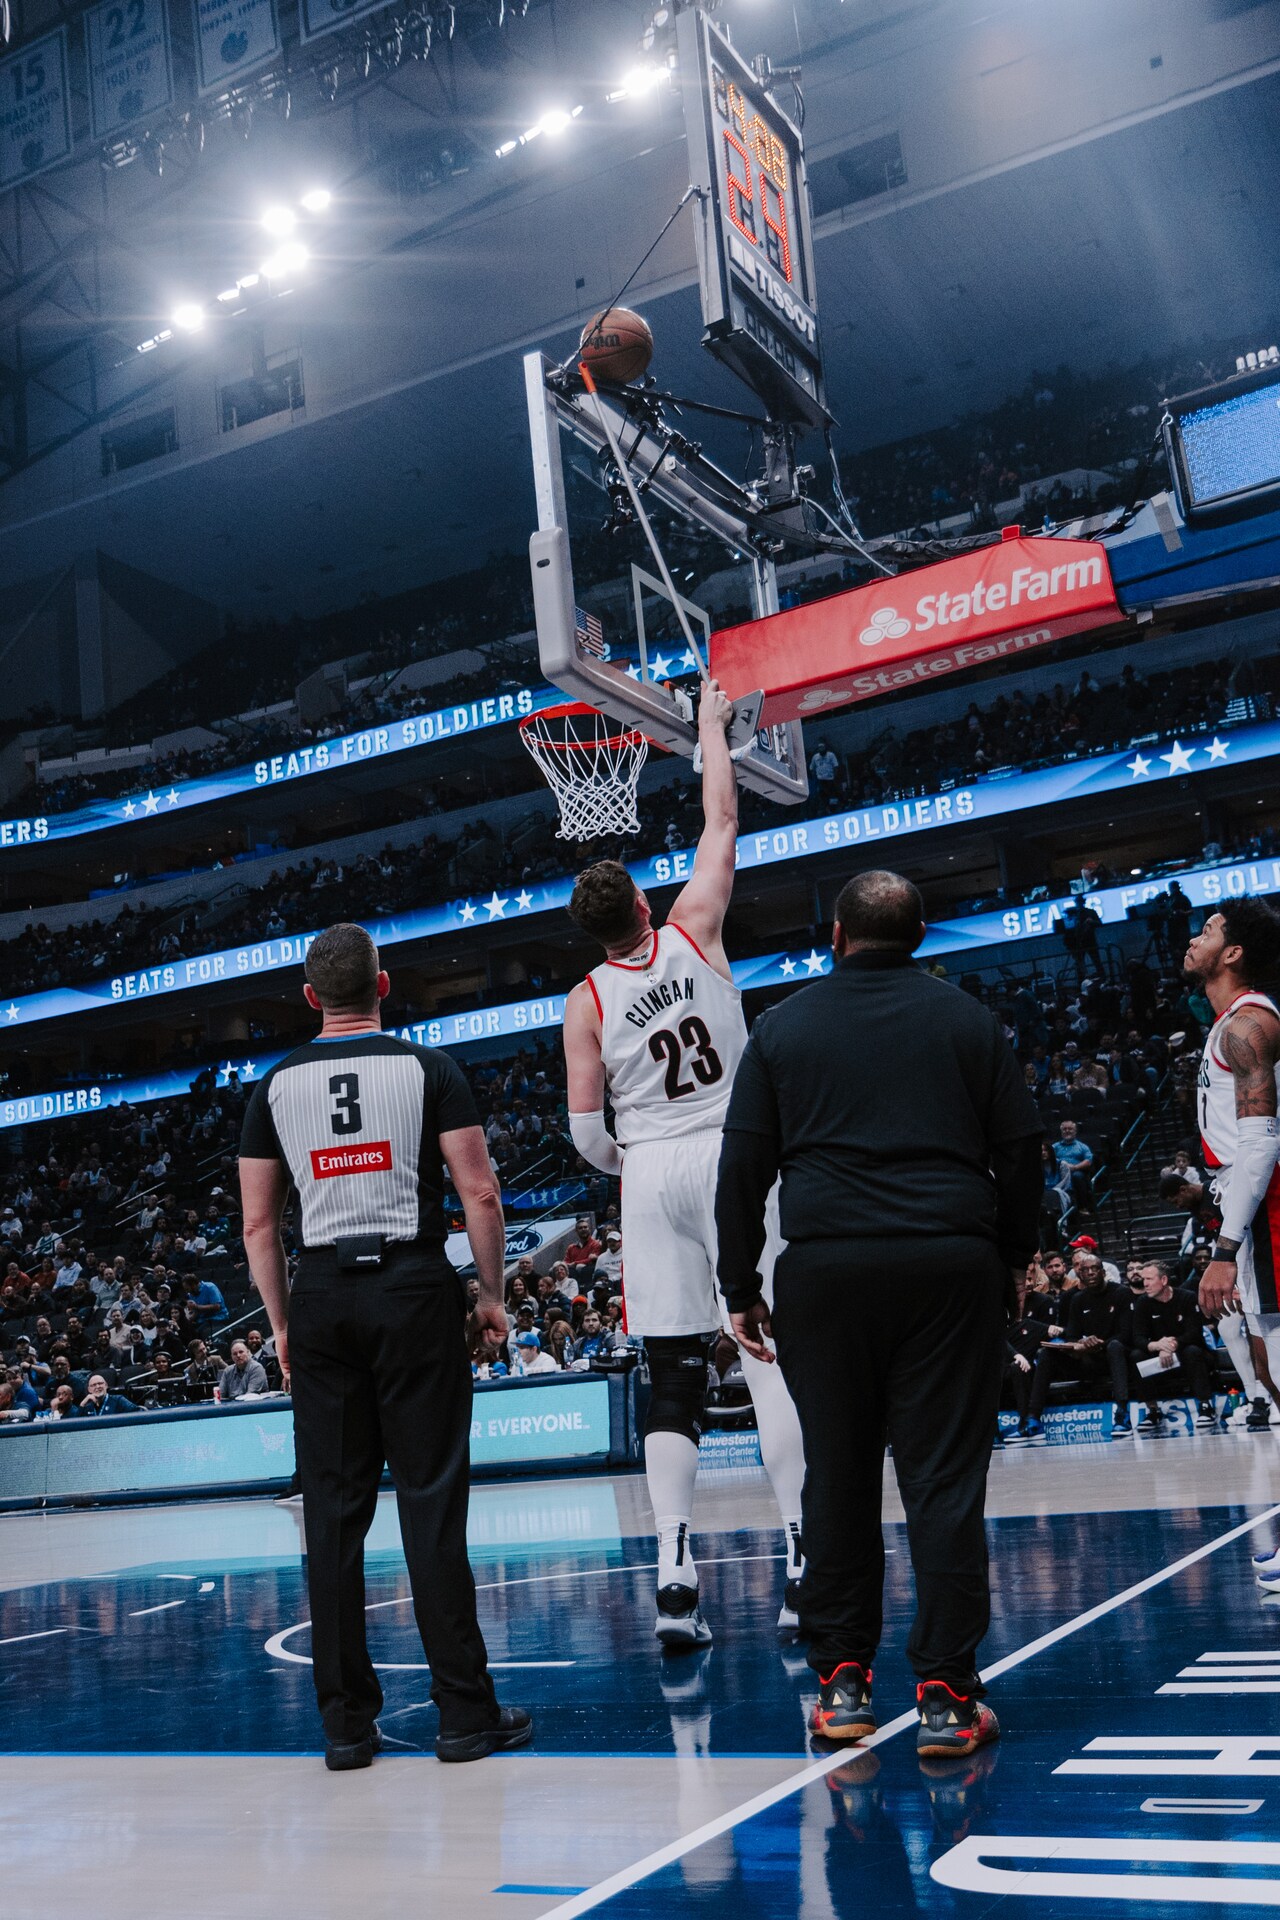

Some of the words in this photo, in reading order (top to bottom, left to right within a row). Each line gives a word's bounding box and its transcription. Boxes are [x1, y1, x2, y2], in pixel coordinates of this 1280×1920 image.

[104, 0, 146, 49] 22
[10, 53, 46, 101] 15
[723, 129, 792, 284] 24
[755, 261, 816, 343] TISSOT
[254, 745, 330, 784] SEATS
[341, 730, 389, 762] FOR
[402, 690, 533, 745] SOLDIERS
[755, 828, 809, 860] FOR
[823, 791, 975, 844] SOLDIERS
[111, 967, 175, 999] SEATS
[185, 956, 226, 983] FOR
[454, 1011, 500, 1039] FOR
[513, 998, 567, 1028] SOL
[625, 977, 694, 1029] CLINGAN
[648, 1015, 723, 1101] 23
[5, 1087, 101, 1122] SOLDIERS
[329, 1072, 362, 1136] 3
[318, 1150, 384, 1171] Emirates
[729, 1446, 757, 1457] Center
[1066, 1422, 1103, 1433] Center
